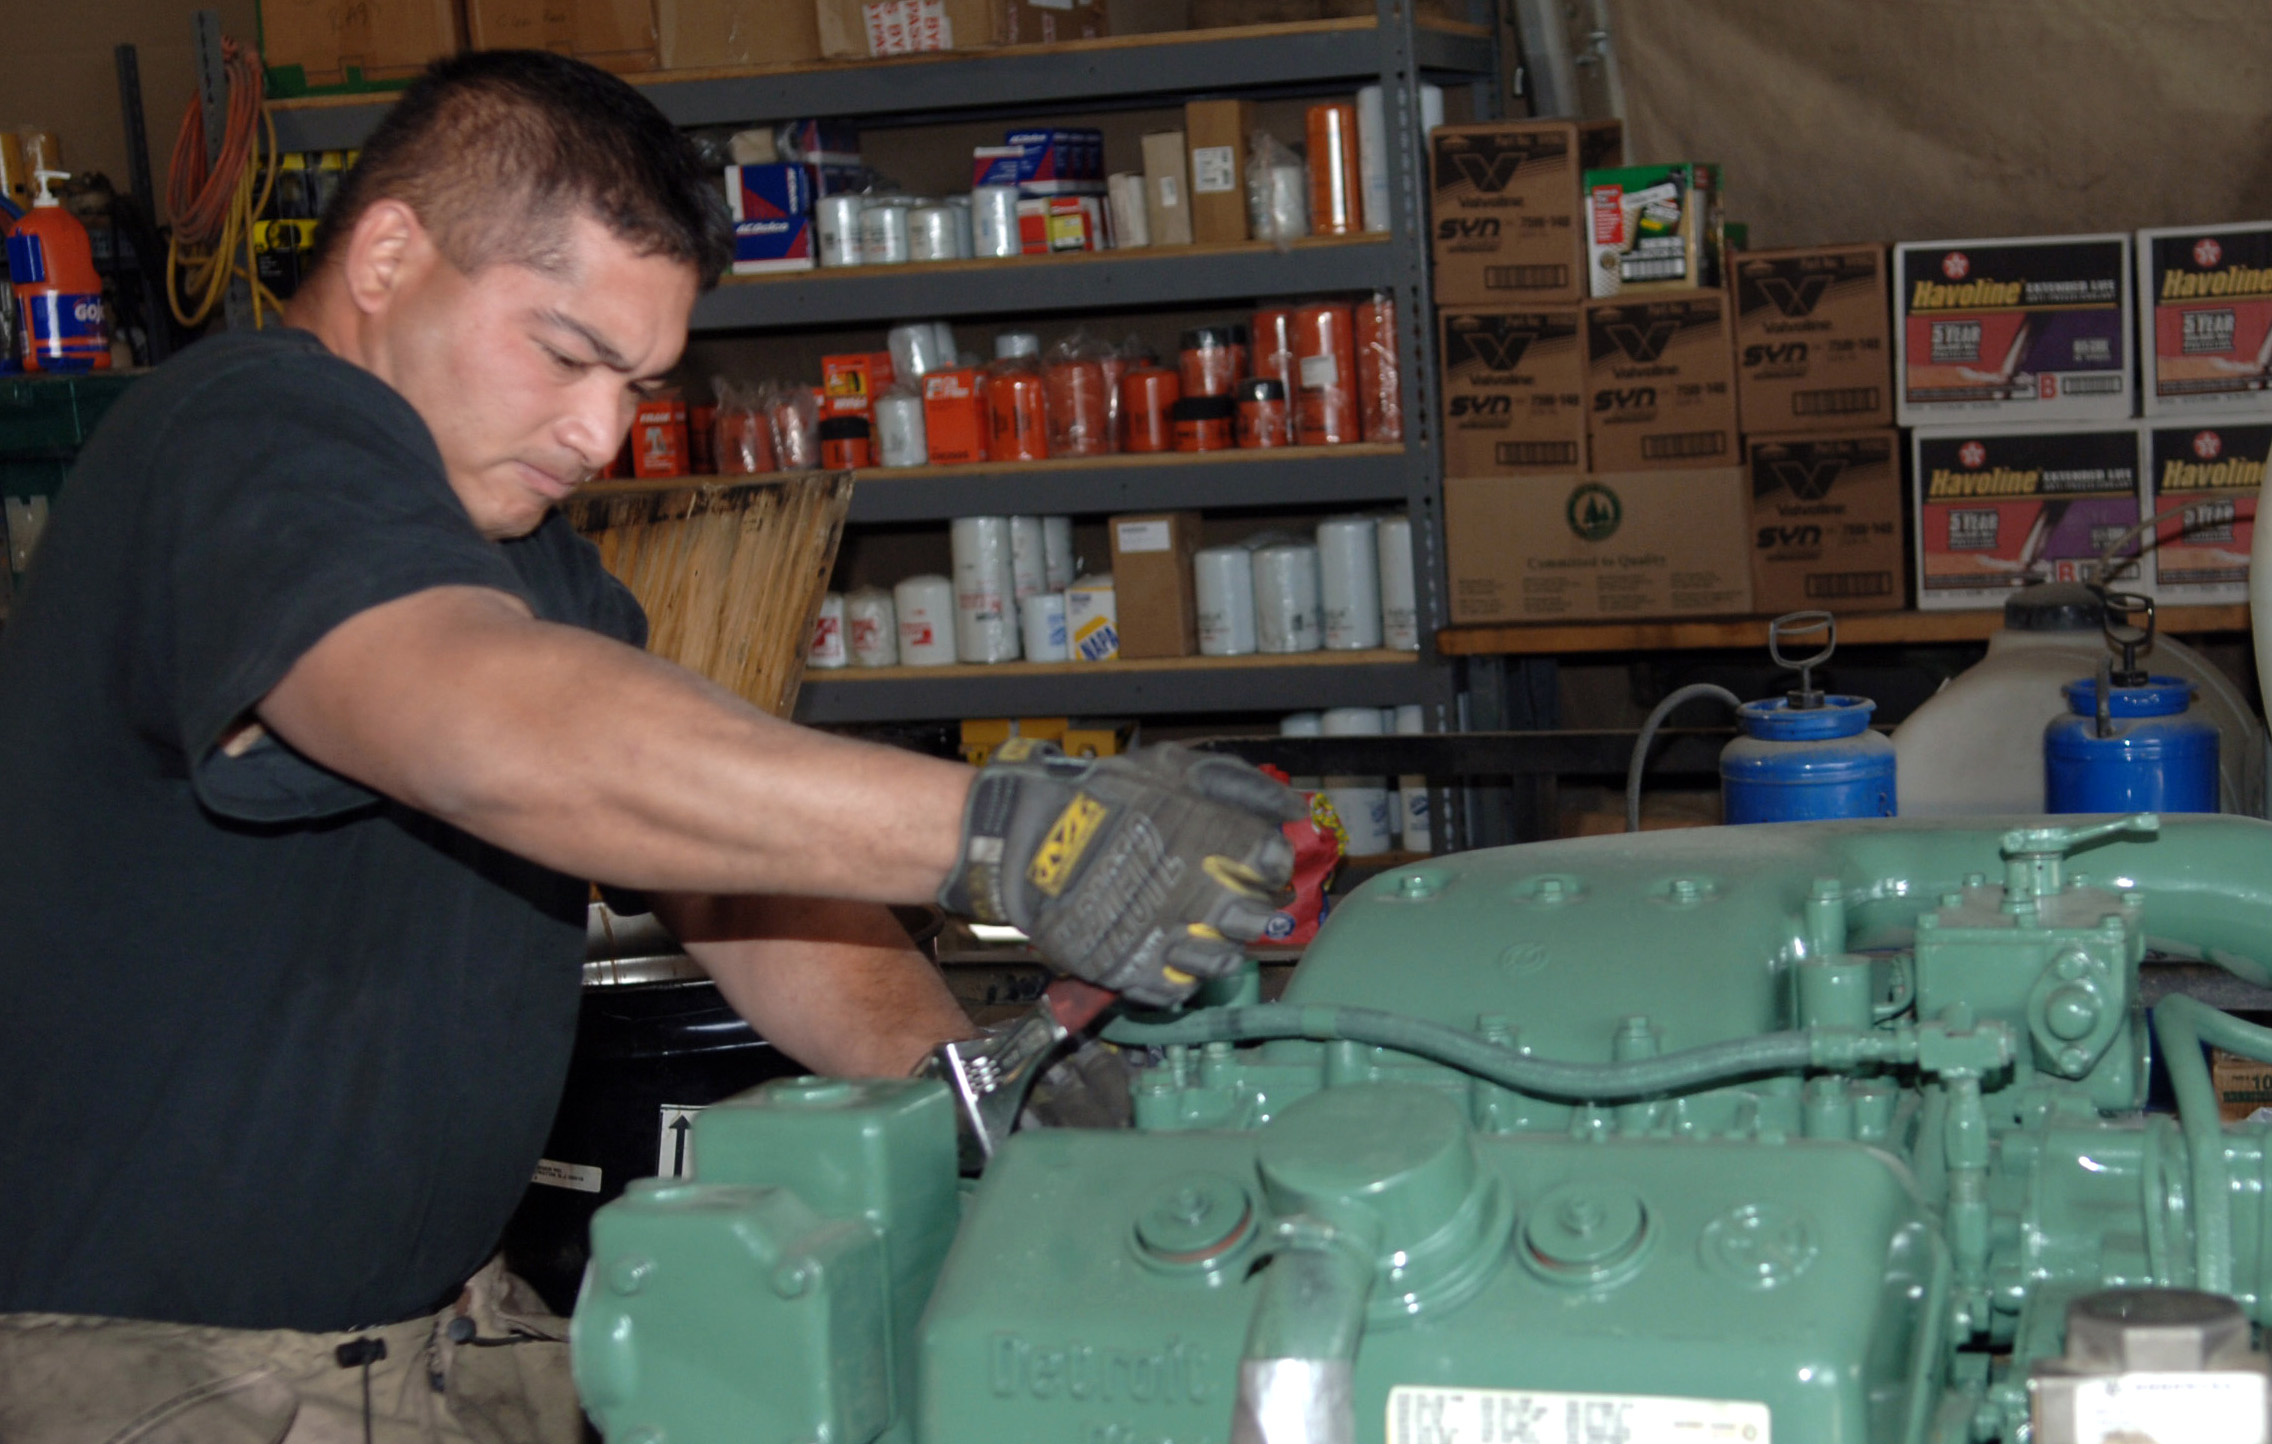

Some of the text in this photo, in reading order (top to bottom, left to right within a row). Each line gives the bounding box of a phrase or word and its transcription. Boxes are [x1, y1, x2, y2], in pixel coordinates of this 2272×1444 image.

[1912, 278, 2022, 308] Havoline
[2161, 264, 2272, 298] Havoline
[1929, 465, 2039, 497] Havoline
[2162, 456, 2267, 489] Havolin
[1079, 625, 1119, 661] NAPA
[987, 1330, 1215, 1405] Detroit
